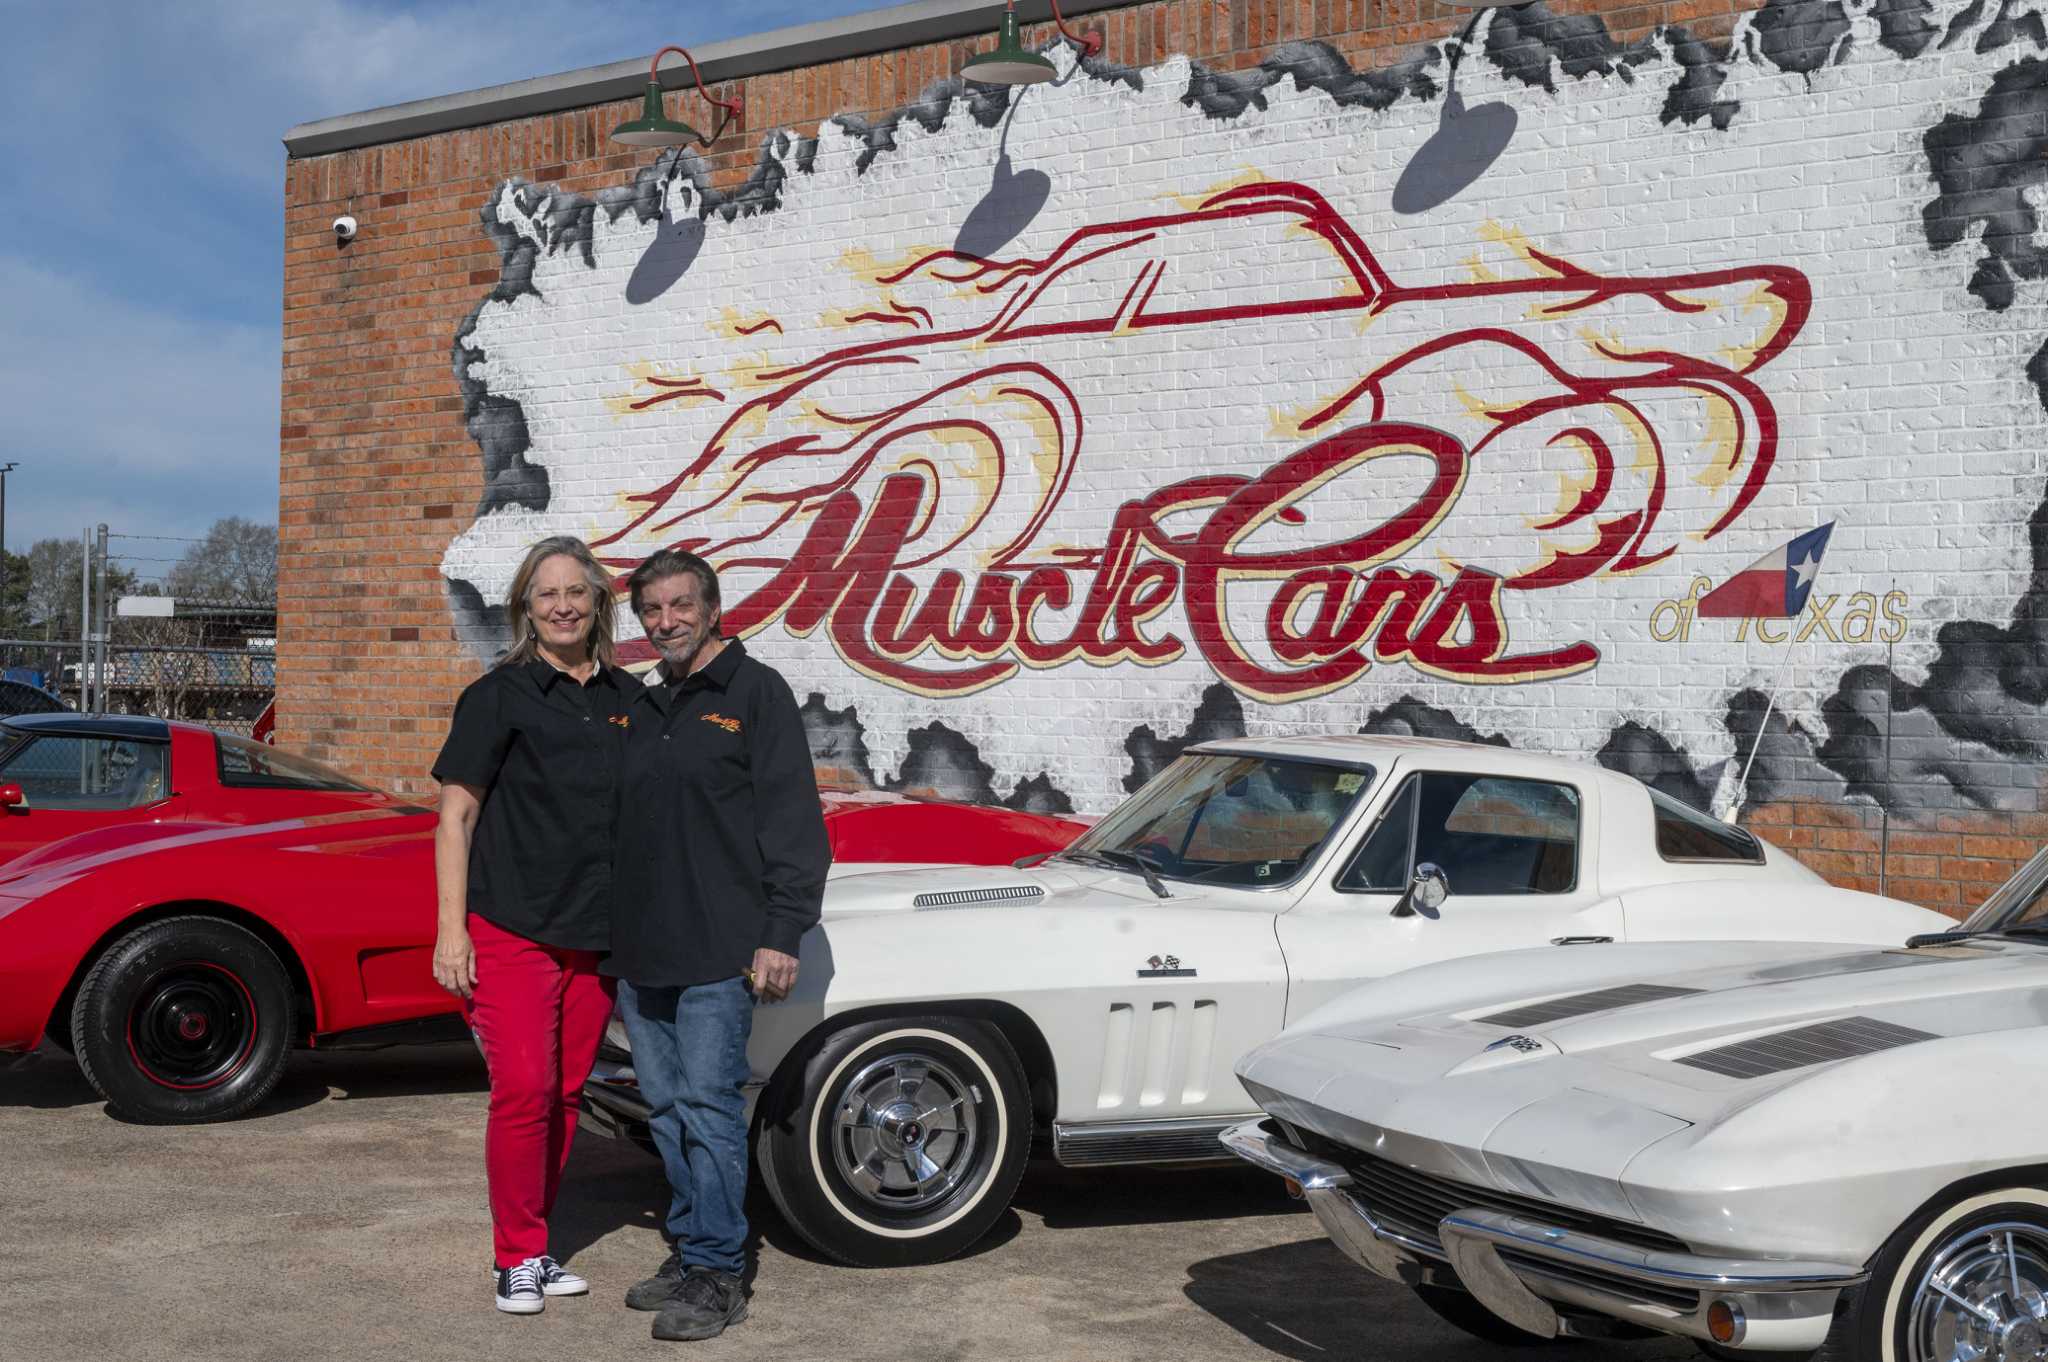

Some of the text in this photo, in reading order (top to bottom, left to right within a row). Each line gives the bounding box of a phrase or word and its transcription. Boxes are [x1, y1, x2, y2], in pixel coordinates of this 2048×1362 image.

[718, 421, 1601, 705] Muscle Cars
[1649, 575, 1712, 643] of
